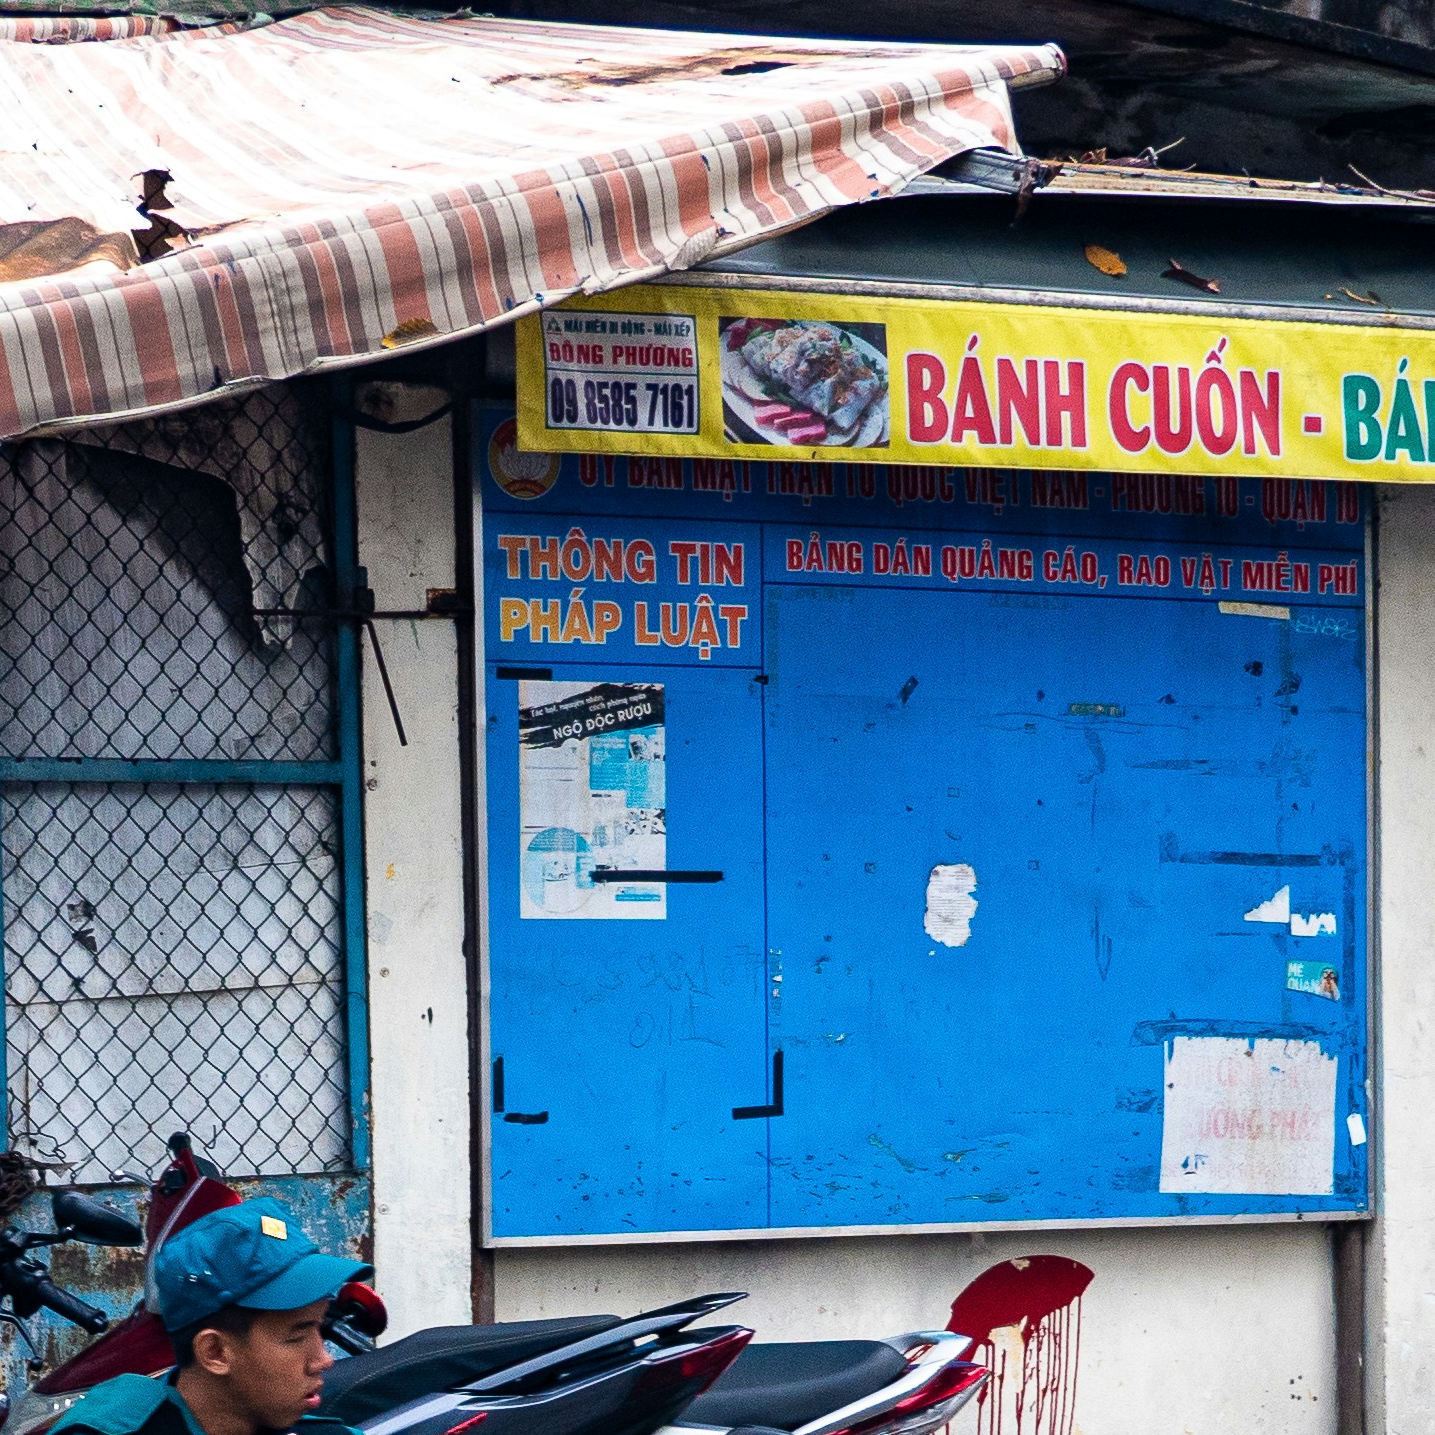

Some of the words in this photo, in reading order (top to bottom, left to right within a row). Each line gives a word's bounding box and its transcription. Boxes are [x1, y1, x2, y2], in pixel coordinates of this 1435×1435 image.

[549, 340, 604, 365] ĐÔNG
[612, 343, 694, 368] PHƯƠNG
[550, 377, 579, 424] 09
[583, 380, 639, 427] 8585
[645, 382, 695, 429] 7161
[905, 334, 1087, 449] BÁNH
[1108, 336, 1282, 457] CUỐN
[1304, 414, 1324, 434] -
[1341, 357, 1435, 464] BÁ
[498, 527, 657, 584] THÔNG
[669, 540, 745, 587] TIN
[786, 530, 864, 574] BẢNG
[872, 537, 932, 577] DÁN
[941, 538, 1034, 583] QUẢNG
[1042, 545, 1108, 589] CÁO,
[1117, 553, 1171, 588] RAO
[1180, 552, 1233, 596] VẶT
[1241, 551, 1311, 594] MIỄN
[1318, 559, 1358, 596] PHÍ
[500, 587, 623, 645] PHÁP
[635, 593, 749, 660] LUẬT
[552, 719, 583, 740] NGỘ
[585, 713, 616, 731] ĐỘC
[617, 702, 653, 722] RƯỢU
